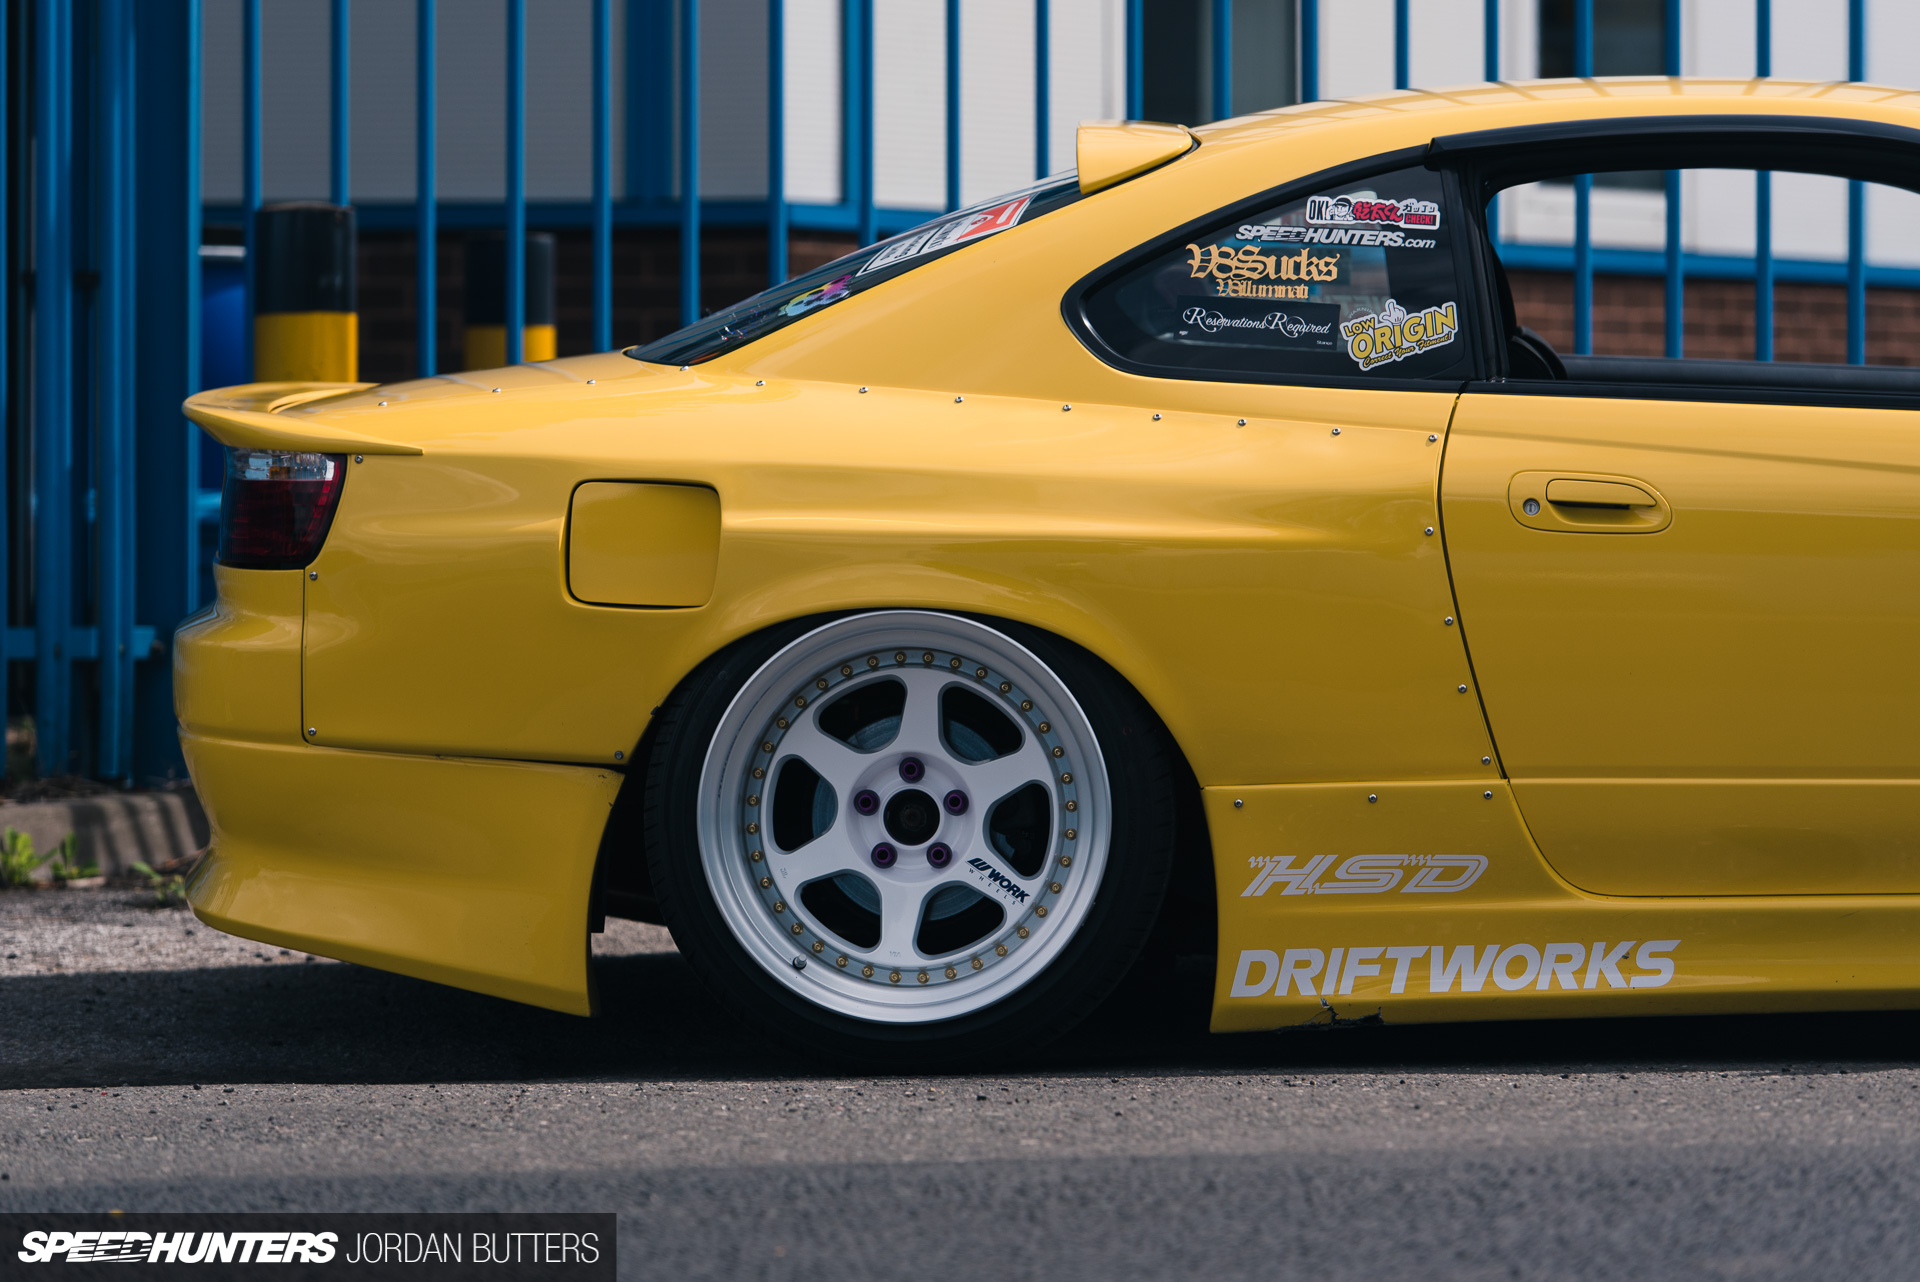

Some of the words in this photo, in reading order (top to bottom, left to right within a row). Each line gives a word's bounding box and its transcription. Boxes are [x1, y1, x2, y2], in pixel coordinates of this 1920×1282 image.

[1405, 214, 1434, 226] CHECK!
[1182, 306, 1266, 333] Reservations
[1264, 312, 1332, 338] Required
[1344, 317, 1376, 338] LOW
[1348, 307, 1375, 319] WARNIN
[1351, 305, 1456, 359] ORIGIN
[1363, 352, 1393, 368] Correct
[1393, 345, 1415, 358] Your
[1416, 331, 1452, 350] Fitment!
[987, 868, 1030, 903] WORK
[1230, 939, 1681, 998] DRIFTWORKS
